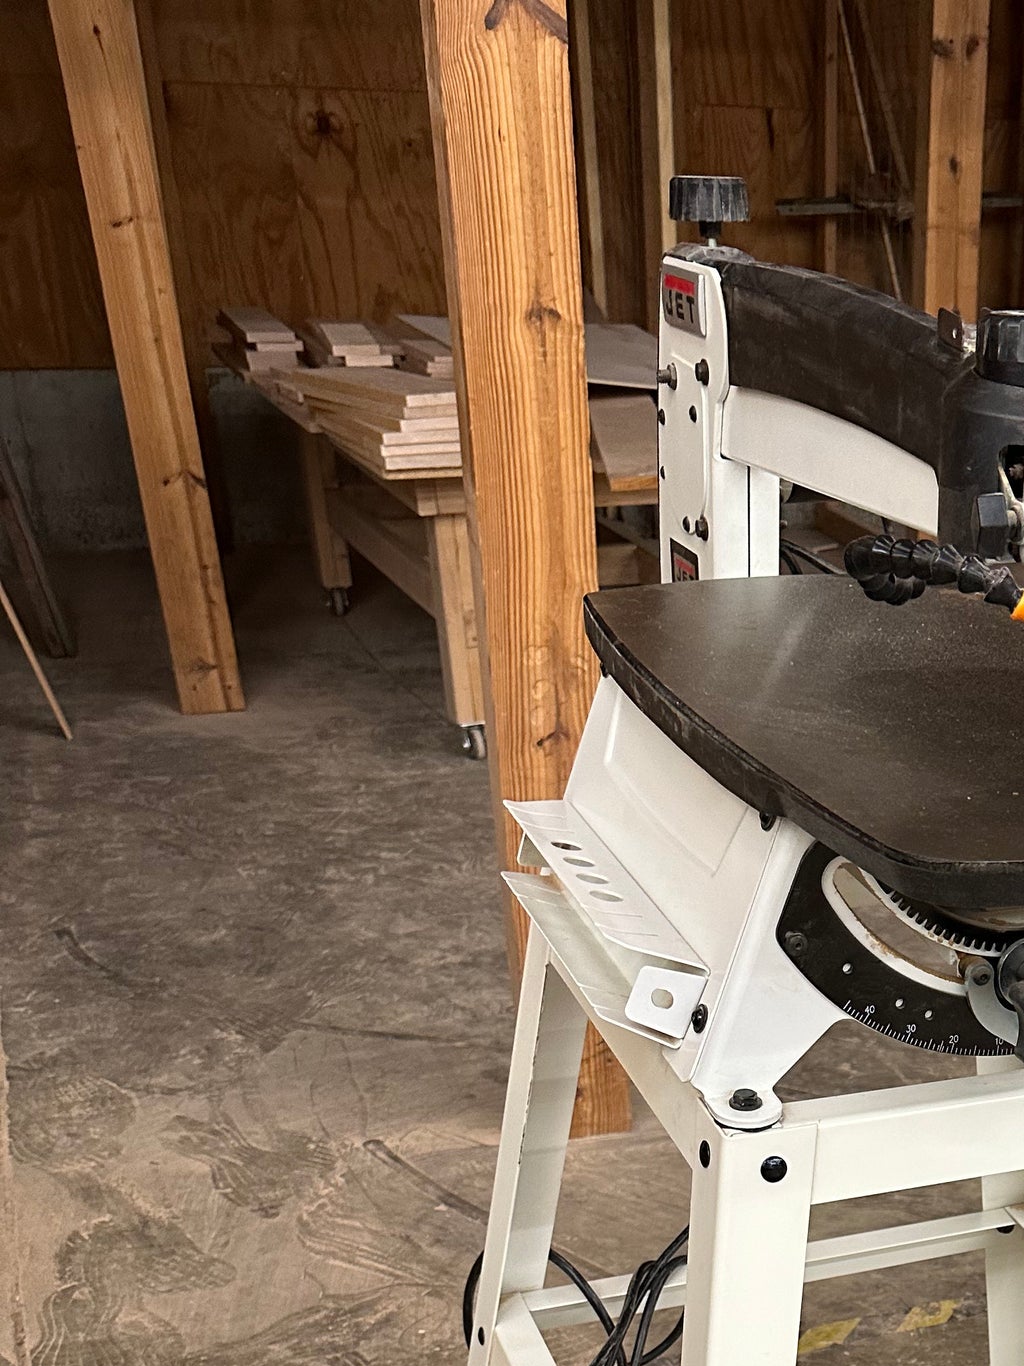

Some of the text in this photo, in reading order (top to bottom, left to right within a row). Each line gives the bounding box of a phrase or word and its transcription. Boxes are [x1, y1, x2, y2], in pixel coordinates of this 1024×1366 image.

[666, 289, 694, 324] JET
[864, 1004, 876, 1014] 40
[905, 1023, 917, 1034] 30
[948, 1034, 959, 1044] 20
[995, 1037, 1004, 1045] 10
